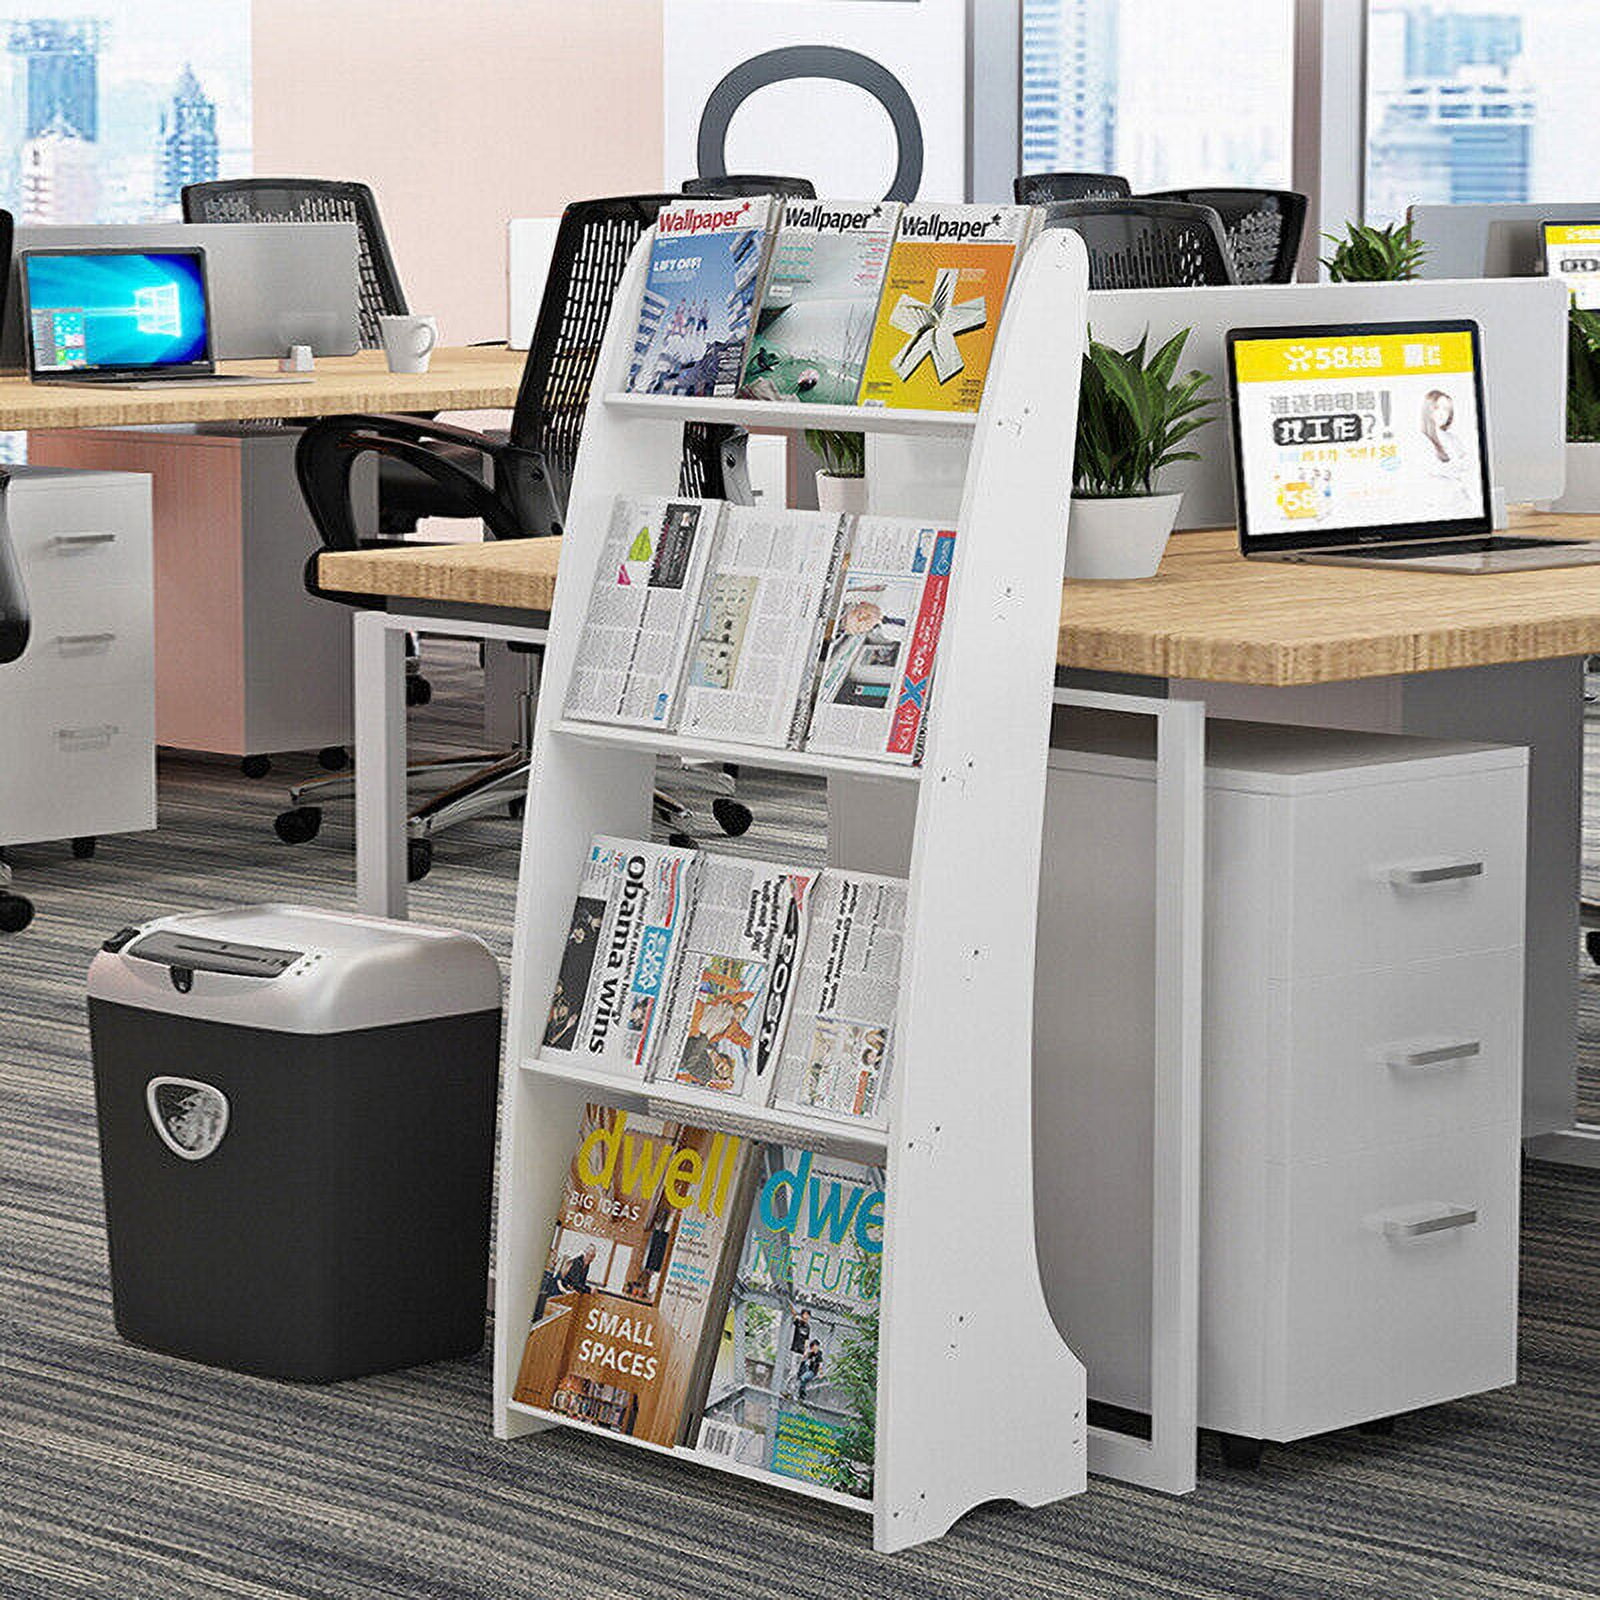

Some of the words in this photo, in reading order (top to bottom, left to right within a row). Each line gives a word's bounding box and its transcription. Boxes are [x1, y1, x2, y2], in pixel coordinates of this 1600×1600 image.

[607, 855, 647, 969] Obama
[589, 977, 619, 1055] wins
[577, 1110, 740, 1219] dwell
[569, 1191, 594, 1210] BIG
[598, 1197, 641, 1221] IDEAS
[752, 1237, 800, 1284] THE
[584, 1308, 655, 1348] SMALL
[579, 1338, 658, 1382] SPACES
